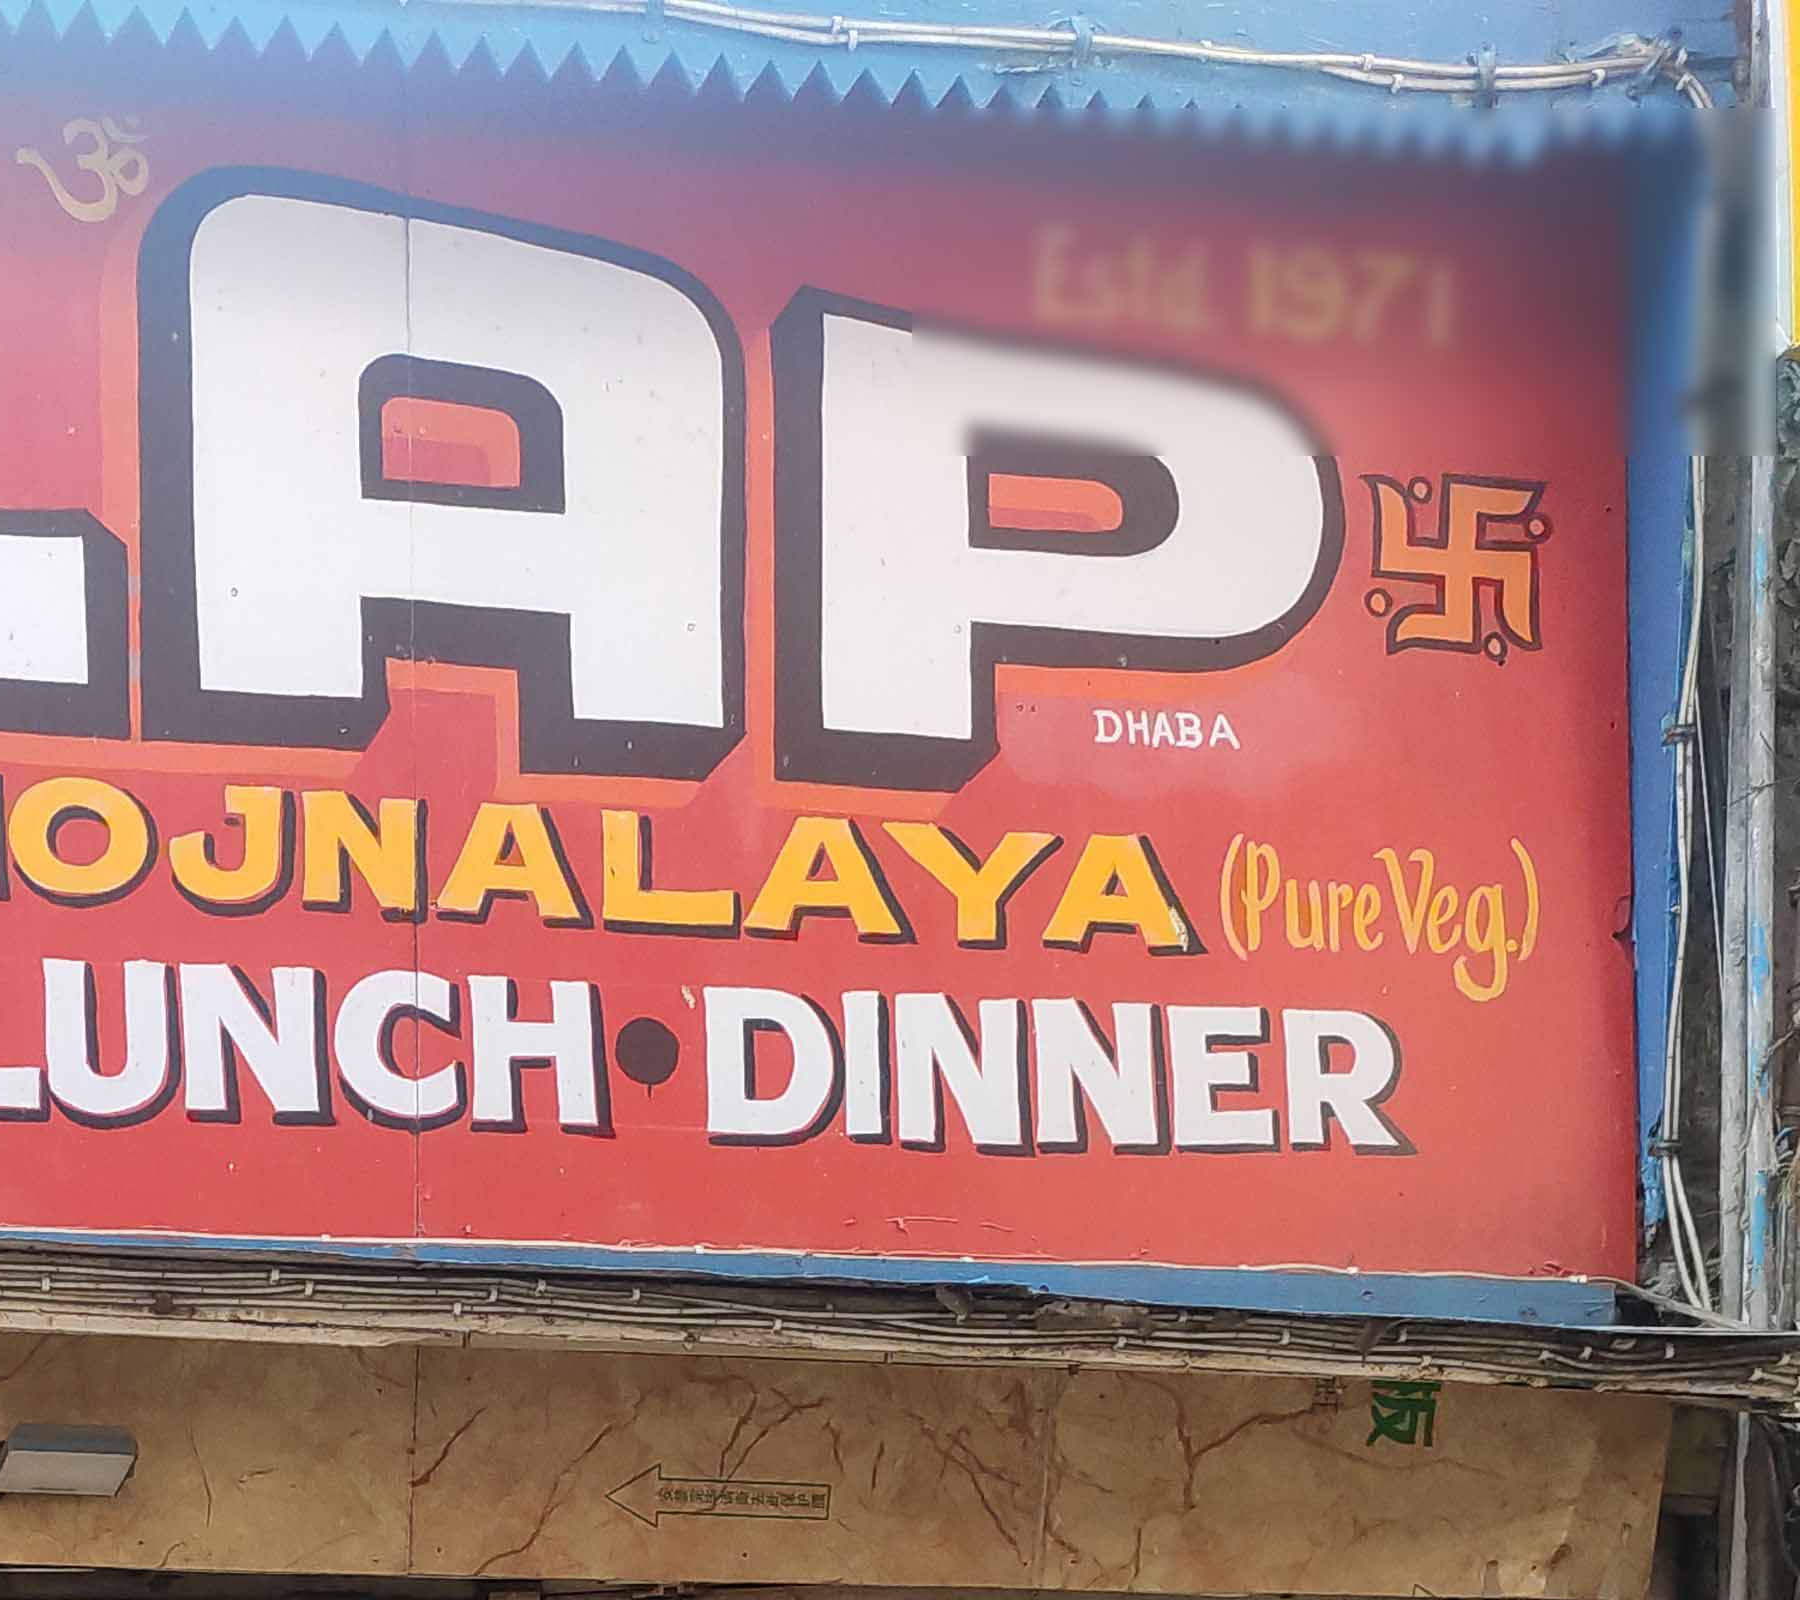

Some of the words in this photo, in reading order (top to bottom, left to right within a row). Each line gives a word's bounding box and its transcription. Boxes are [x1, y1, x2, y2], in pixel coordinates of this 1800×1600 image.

[1250, 240, 1458, 348] 1971
[1093, 708, 1241, 750] DHABA
[705, 984, 1419, 1158] DINNER
